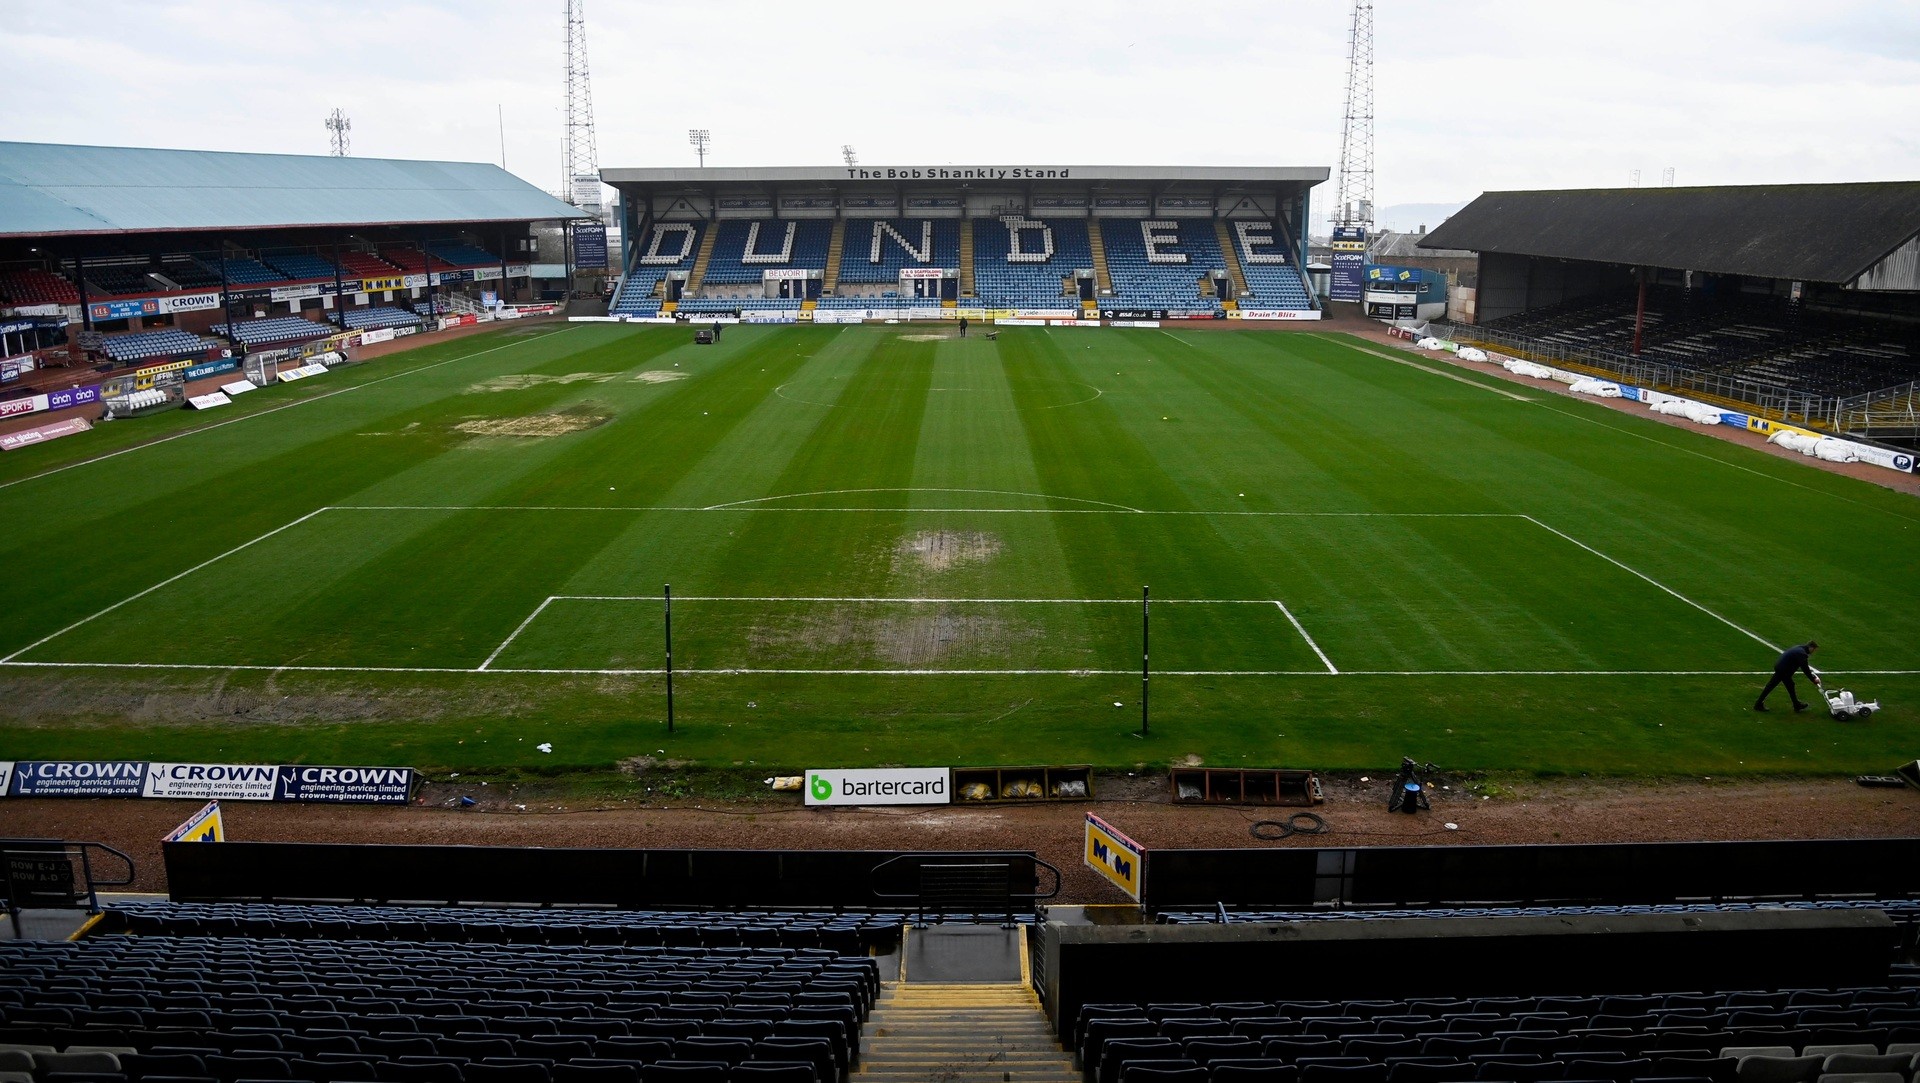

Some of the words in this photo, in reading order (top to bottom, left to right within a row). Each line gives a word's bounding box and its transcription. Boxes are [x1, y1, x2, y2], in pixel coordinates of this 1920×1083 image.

[848, 168, 882, 178] The
[887, 168, 922, 178] Bob
[927, 168, 1007, 179] Shankly
[1012, 168, 1070, 178] Stand
[172, 296, 214, 307] CROWN
[52, 394, 71, 405] cinch
[76, 389, 94, 400] cinch
[0, 401, 32, 414] SPORTS
[38, 763, 143, 778] CROWN
[171, 766, 274, 781] CROWN
[302, 768, 408, 784] CROWN
[36, 778, 80, 787] engineering
[169, 781, 212, 790] engineering
[842, 776, 944, 796] bartercard
[168, 790, 270, 798] crown-engineering.co.uk
[301, 784, 344, 793] engineering
[11, 861, 33, 870] ROW
[1094, 838, 1130, 882] MKM
[12, 872, 35, 880] ROW
